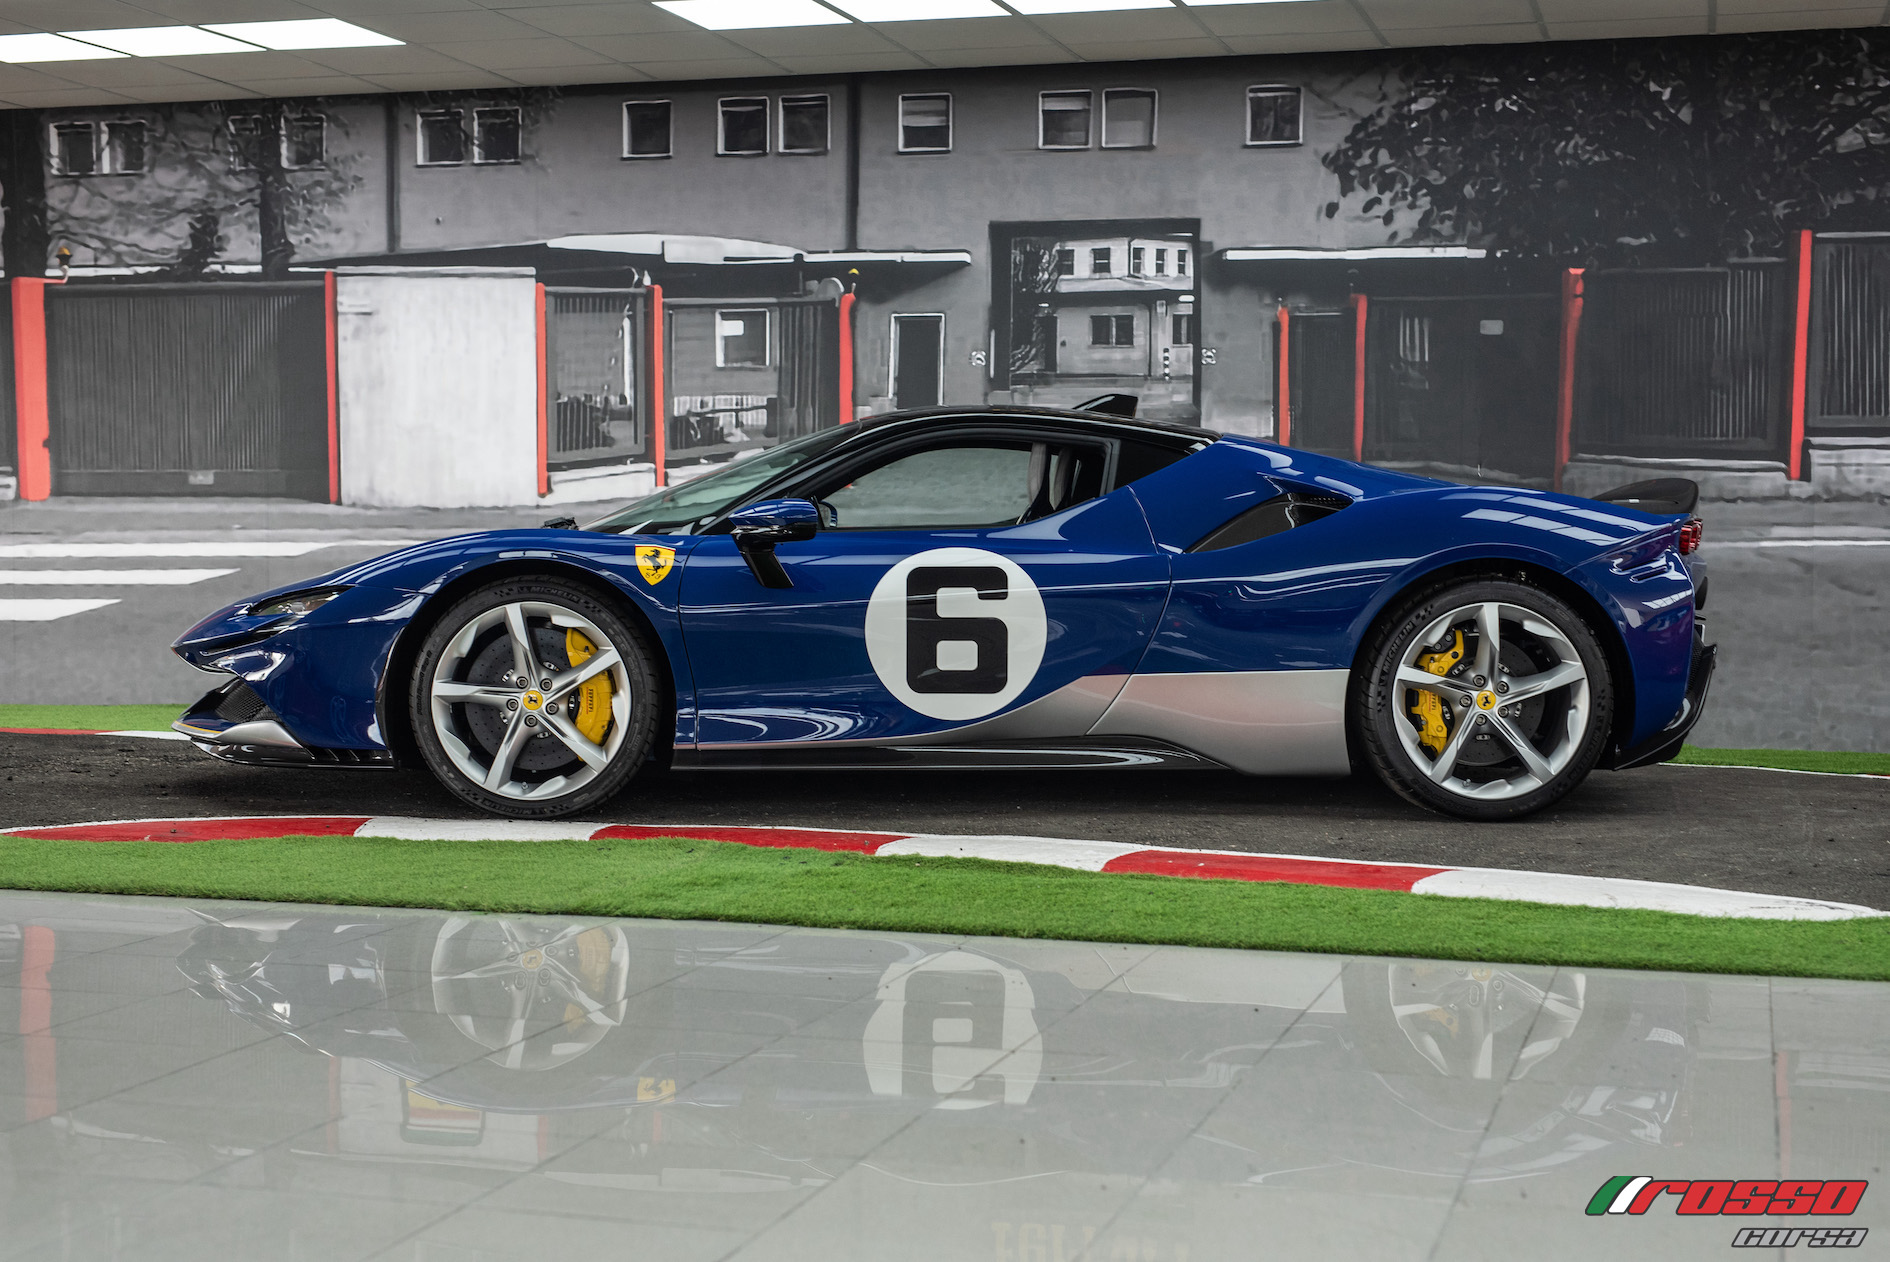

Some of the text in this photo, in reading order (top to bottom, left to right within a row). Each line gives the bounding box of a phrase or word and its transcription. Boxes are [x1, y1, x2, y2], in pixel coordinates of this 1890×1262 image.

[530, 586, 579, 602] MICHELIN
[906, 566, 1008, 694] 6
[1383, 621, 1415, 673] MICHELIN
